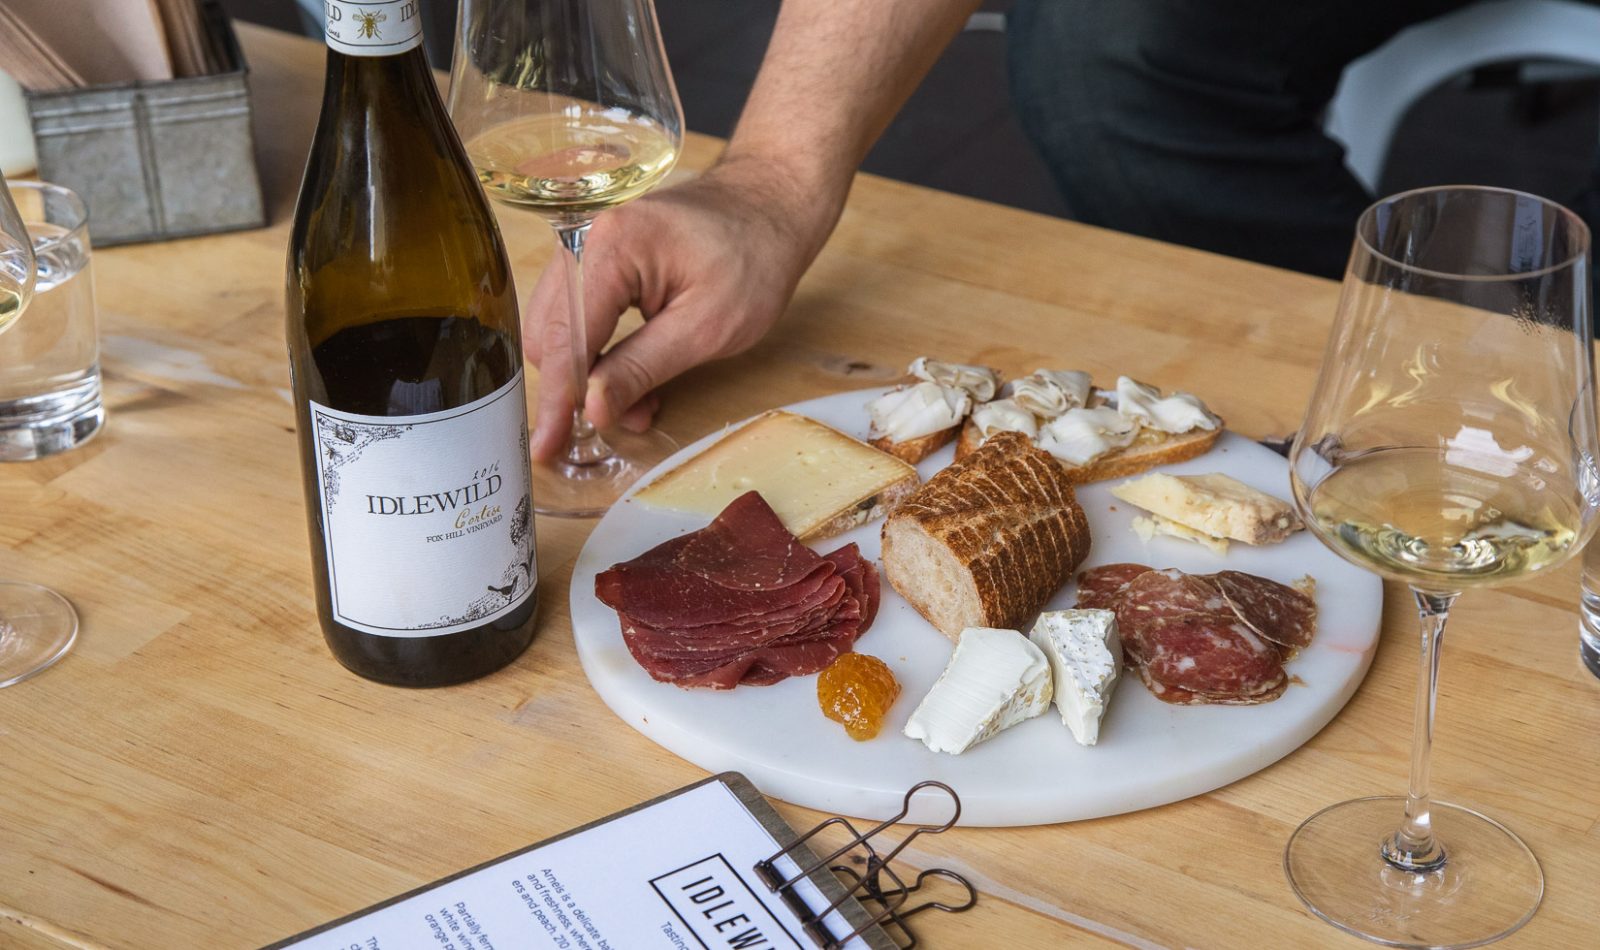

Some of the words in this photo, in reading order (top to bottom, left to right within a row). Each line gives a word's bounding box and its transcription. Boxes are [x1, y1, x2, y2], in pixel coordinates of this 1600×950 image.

[472, 459, 500, 481] 2016
[366, 474, 502, 516] IDLEWILD
[426, 534, 444, 543] FOX
[445, 530, 466, 541] HILL
[466, 514, 504, 535] VINEYARD
[455, 504, 502, 529] Cortese
[511, 879, 526, 895] ers
[521, 892, 541, 910] and
[527, 873, 546, 892] and
[440, 907, 460, 932] white
[454, 901, 482, 935] Partially
[541, 868, 566, 894] Arneis
[561, 892, 572, 903] is
[567, 901, 576, 909] a
[572, 908, 601, 941] delicate
[681, 876, 776, 950] IDLEW
[424, 913, 449, 943] orange
